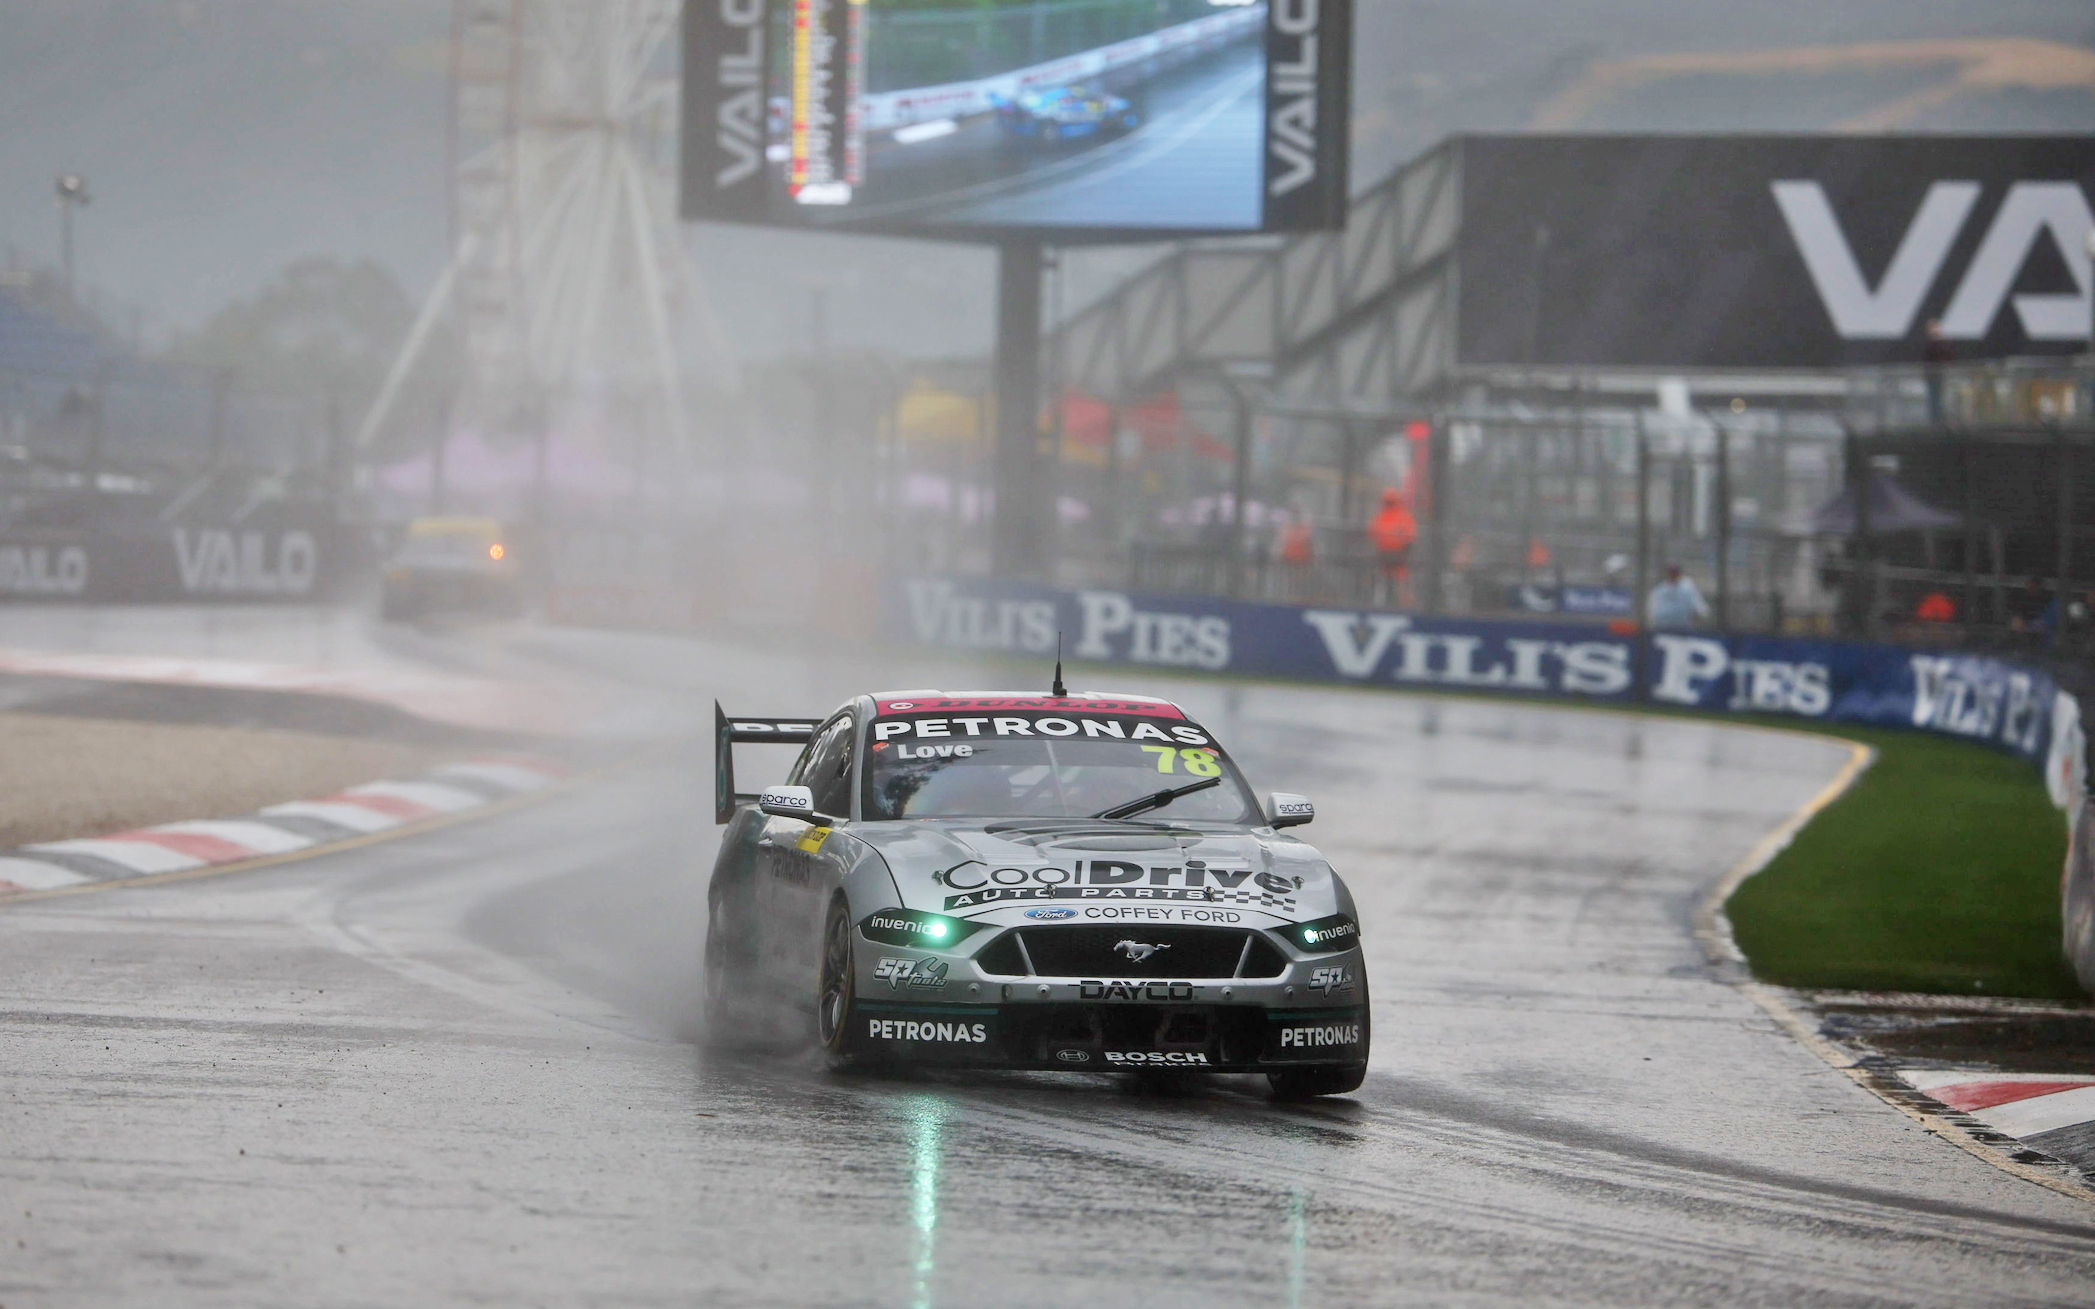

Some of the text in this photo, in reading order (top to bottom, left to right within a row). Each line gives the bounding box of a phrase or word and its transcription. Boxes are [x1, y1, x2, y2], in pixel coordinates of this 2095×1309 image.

[1270, 0, 1318, 198] VAILO
[1074, 591, 1231, 669] PIES
[1304, 610, 1833, 717] VILI'S PIES
[930, 699, 1157, 711] DUNLOP
[874, 717, 1209, 745] PETRONAS
[898, 744, 973, 760] Love
[1140, 745, 1222, 777] 78
[761, 794, 807, 807] sparco
[943, 860, 1293, 894] CoolDrive
[953, 888, 1205, 907] AUTO PARTS
[1084, 907, 1241, 923] COFFEY FORD
[1313, 922, 1356, 942] invenio
[1080, 980, 1193, 1001] DAYCO
[869, 1019, 987, 1043] PETRONAS
[1281, 1025, 1359, 1047] PETRONAS
[1104, 1051, 1208, 1063] BOSCH
